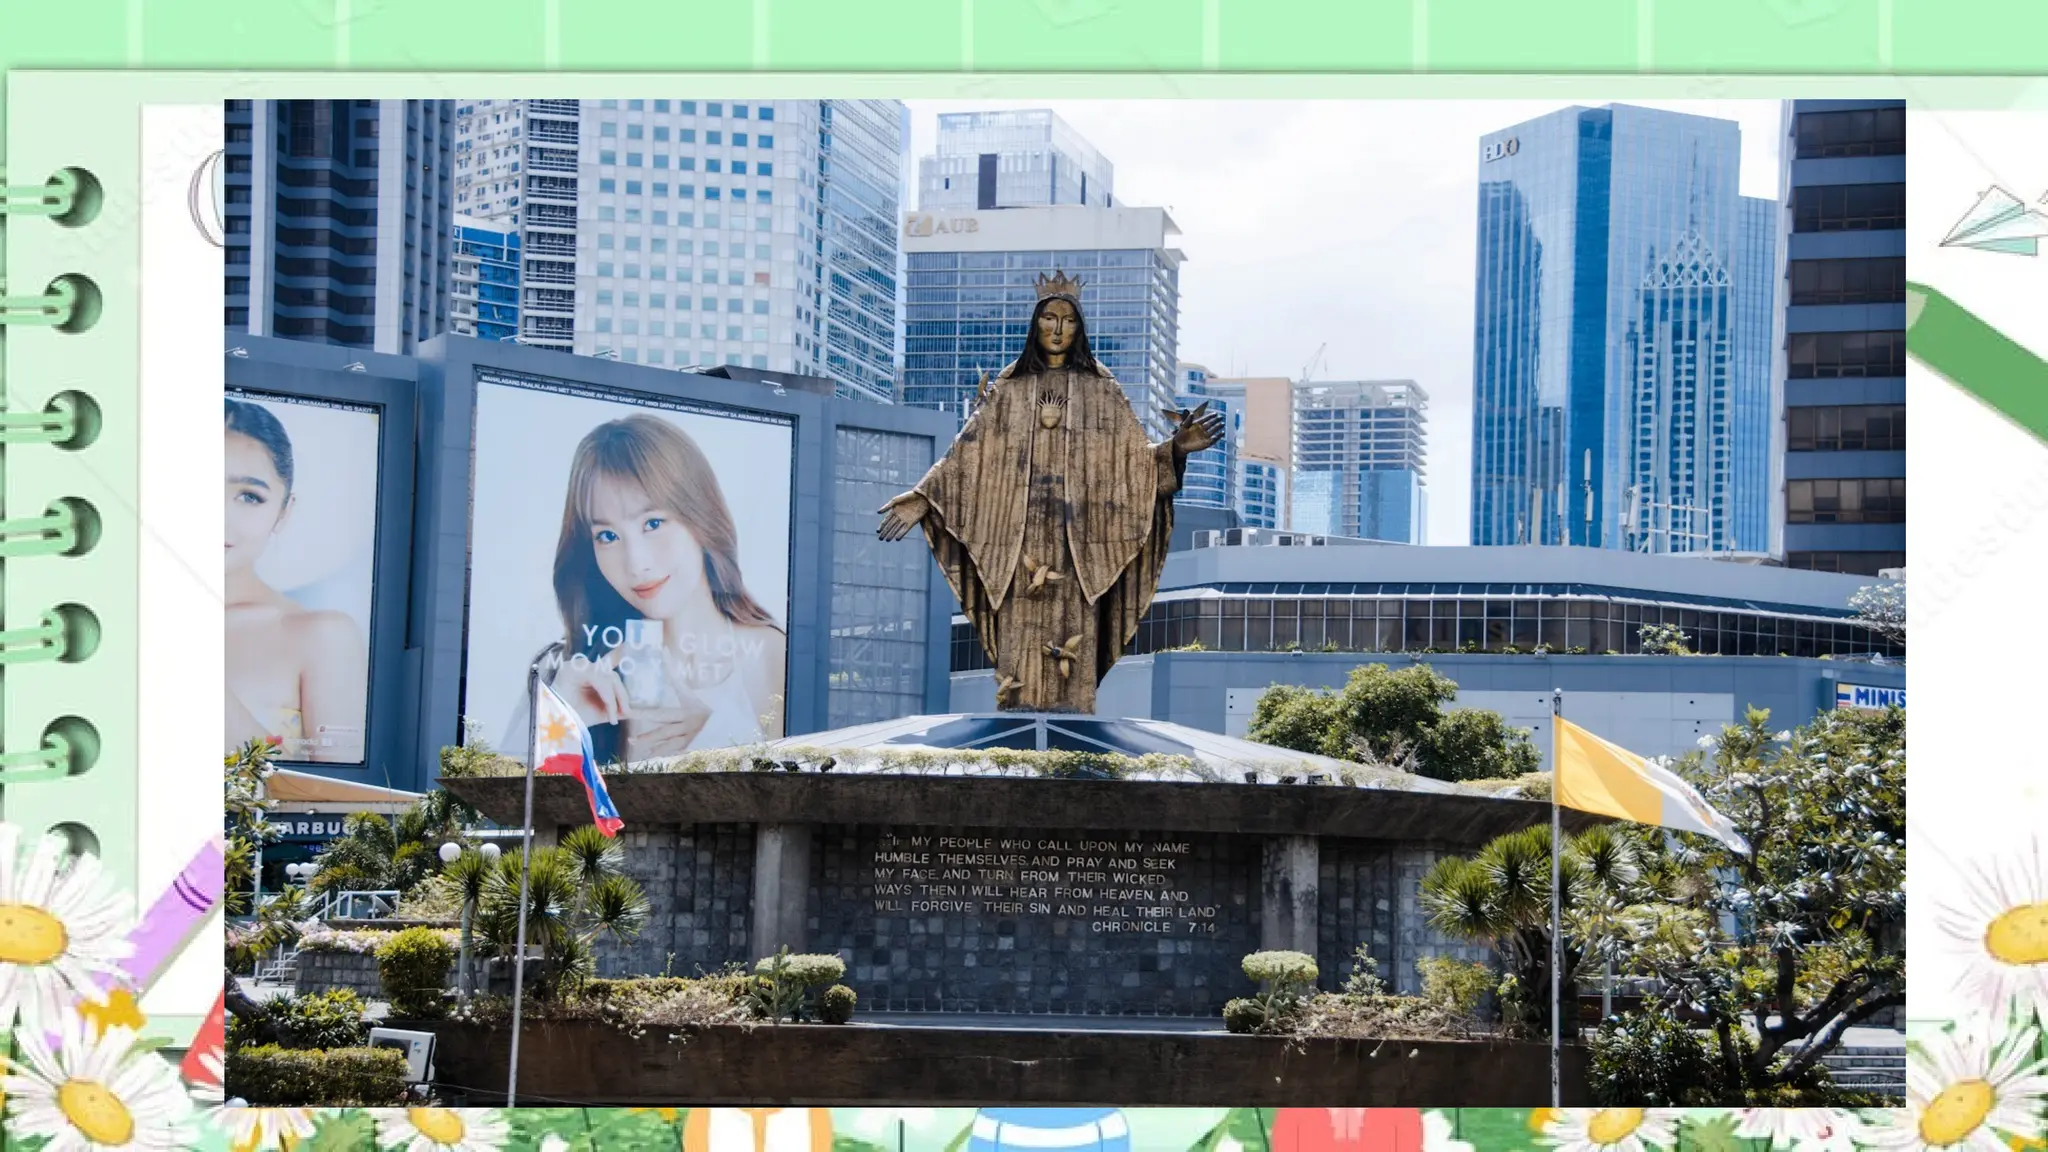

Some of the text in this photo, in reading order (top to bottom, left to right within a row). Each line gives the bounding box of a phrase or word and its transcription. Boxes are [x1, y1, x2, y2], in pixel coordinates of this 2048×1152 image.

[1483, 137, 1520, 162] BDO
[935, 217, 979, 234] AUB
[679, 632, 765, 657] GLOW
[546, 651, 635, 675] MOMO
[1855, 687, 1906, 708] MINIS
[911, 836, 932, 847] MY
[939, 837, 992, 849] PEOPLE
[1000, 839, 1032, 850] WHO
[1037, 840, 1073, 851] CALL
[1080, 840, 1117, 852] UPON
[1124, 842, 1144, 853] MY
[1152, 843, 1190, 853] NAME
[874, 852, 930, 864] HUMBLE
[1031, 856, 1060, 867] AND
[1067, 857, 1103, 868] PRAY
[1108, 858, 1137, 869] AND
[1143, 858, 1176, 869] SEEK
[874, 868, 895, 878] MY
[942, 869, 971, 880] AND
[978, 869, 1014, 880] TURN
[1020, 871, 1059, 882] FROM
[1068, 871, 1106, 883] THEIR
[1113, 873, 1166, 885] WICKED
[874, 884, 912, 895] WAYS
[920, 885, 957, 896] THEN
[971, 886, 1003, 896] WILL
[1010, 887, 1047, 899] HEAR
[1054, 888, 1093, 899] FROM
[1160, 890, 1189, 901] AND
[874, 900, 903, 911] WILL
[911, 901, 973, 912] FORGIVE
[984, 901, 1024, 913] THEIR
[1029, 903, 1051, 914] SIN
[1057, 905, 1086, 915] AND
[1093, 906, 1130, 917] HEAL
[1136, 906, 1174, 918] THEIR
[1092, 921, 1215, 933] CHRONICLE 7:14
